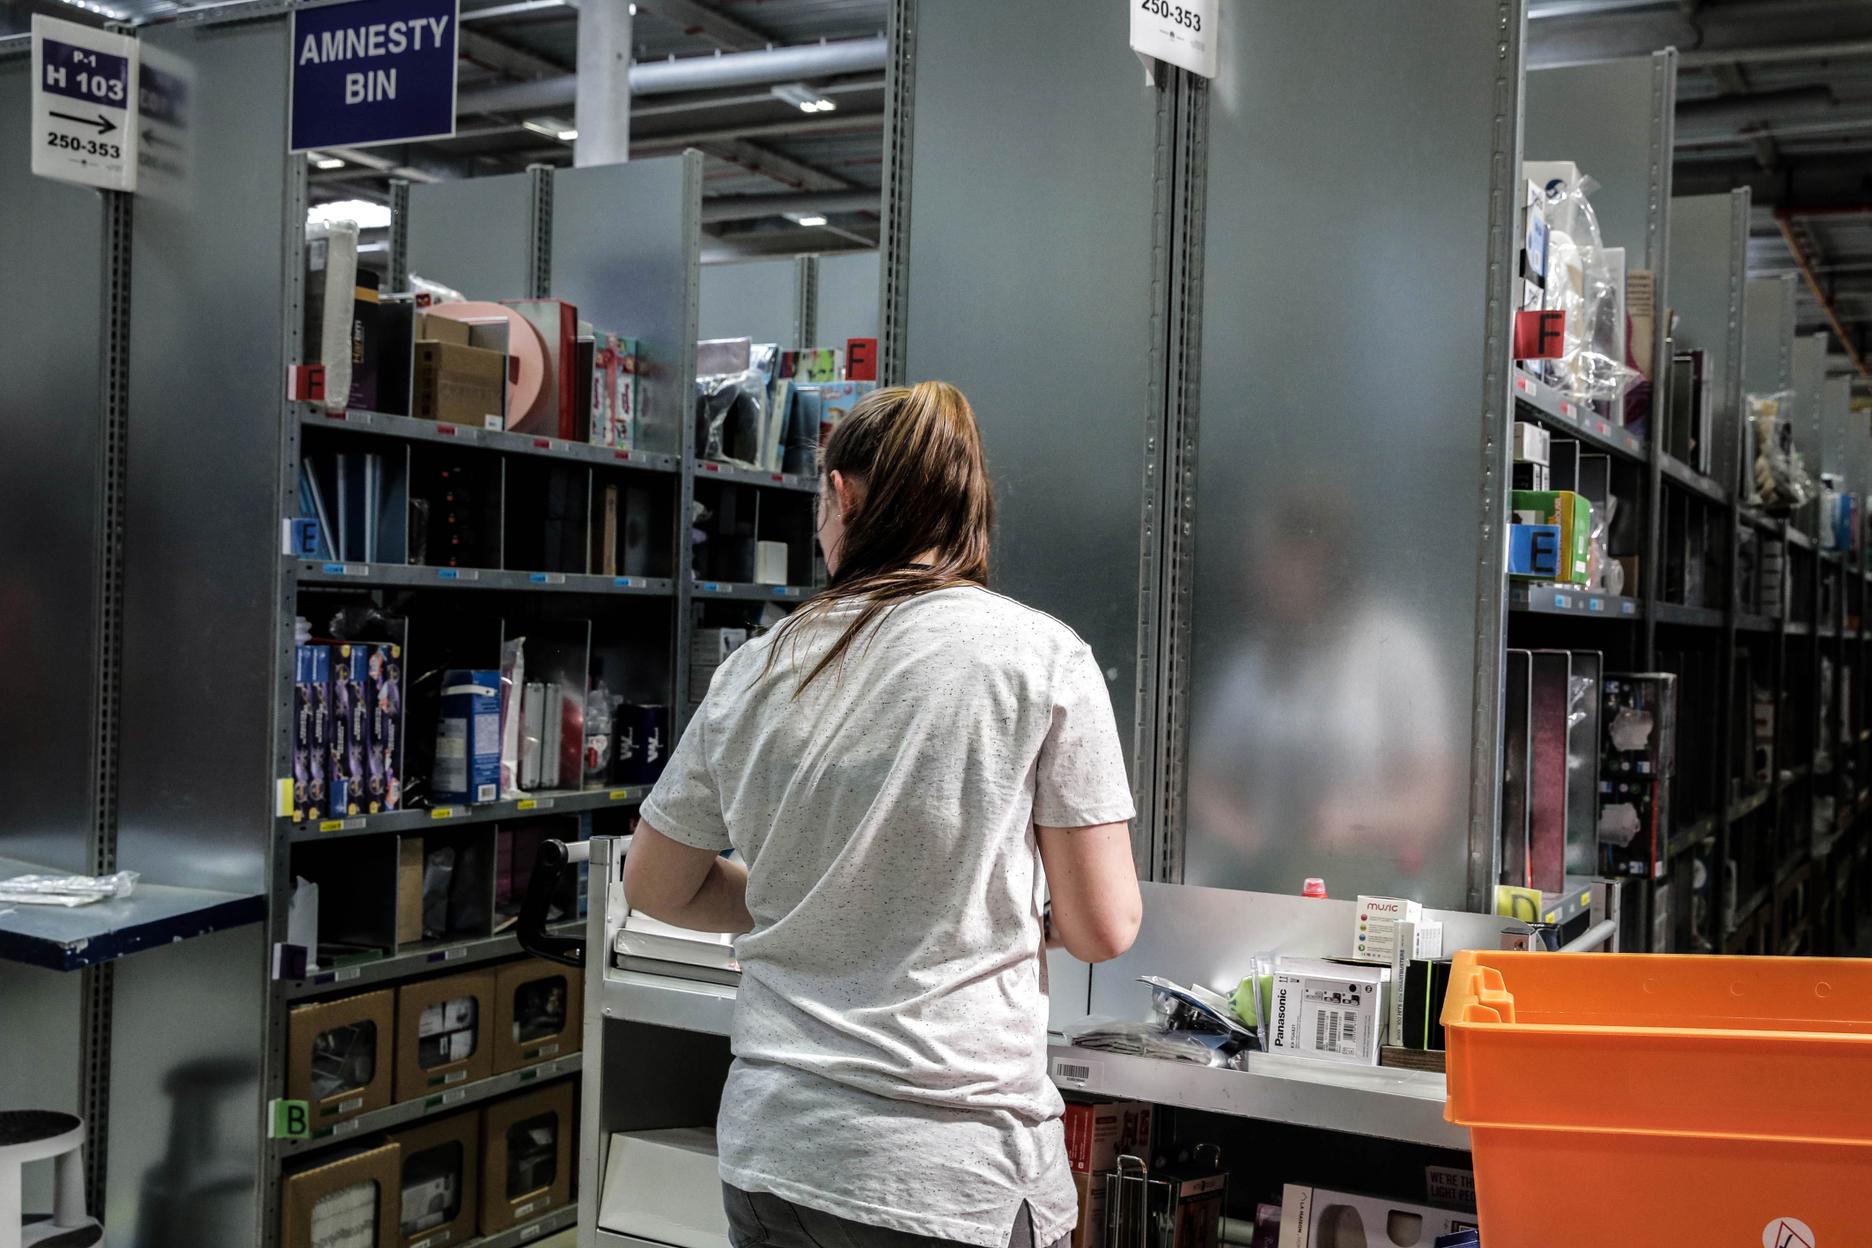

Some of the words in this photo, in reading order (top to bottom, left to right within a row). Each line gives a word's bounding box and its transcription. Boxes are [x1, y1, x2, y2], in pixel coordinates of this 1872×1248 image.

[1141, 0, 1202, 32] 250-353
[299, 15, 449, 66] AMNESTY
[72, 51, 97, 68] P-1
[46, 64, 67, 88] H
[76, 72, 124, 101] 103
[345, 68, 397, 105] BIN
[47, 132, 121, 159] 250-353
[1538, 313, 1562, 354] F
[847, 343, 866, 377] F
[308, 369, 323, 400] F
[303, 523, 317, 553] E
[1531, 531, 1555, 573] E
[1367, 903, 1399, 912] music
[1512, 894, 1537, 922] D
[1275, 988, 1287, 1047] Panasonic
[288, 1105, 306, 1135] B
[1431, 1185, 1456, 1199] LIGHT
[1461, 1176, 1474, 1188] TH
